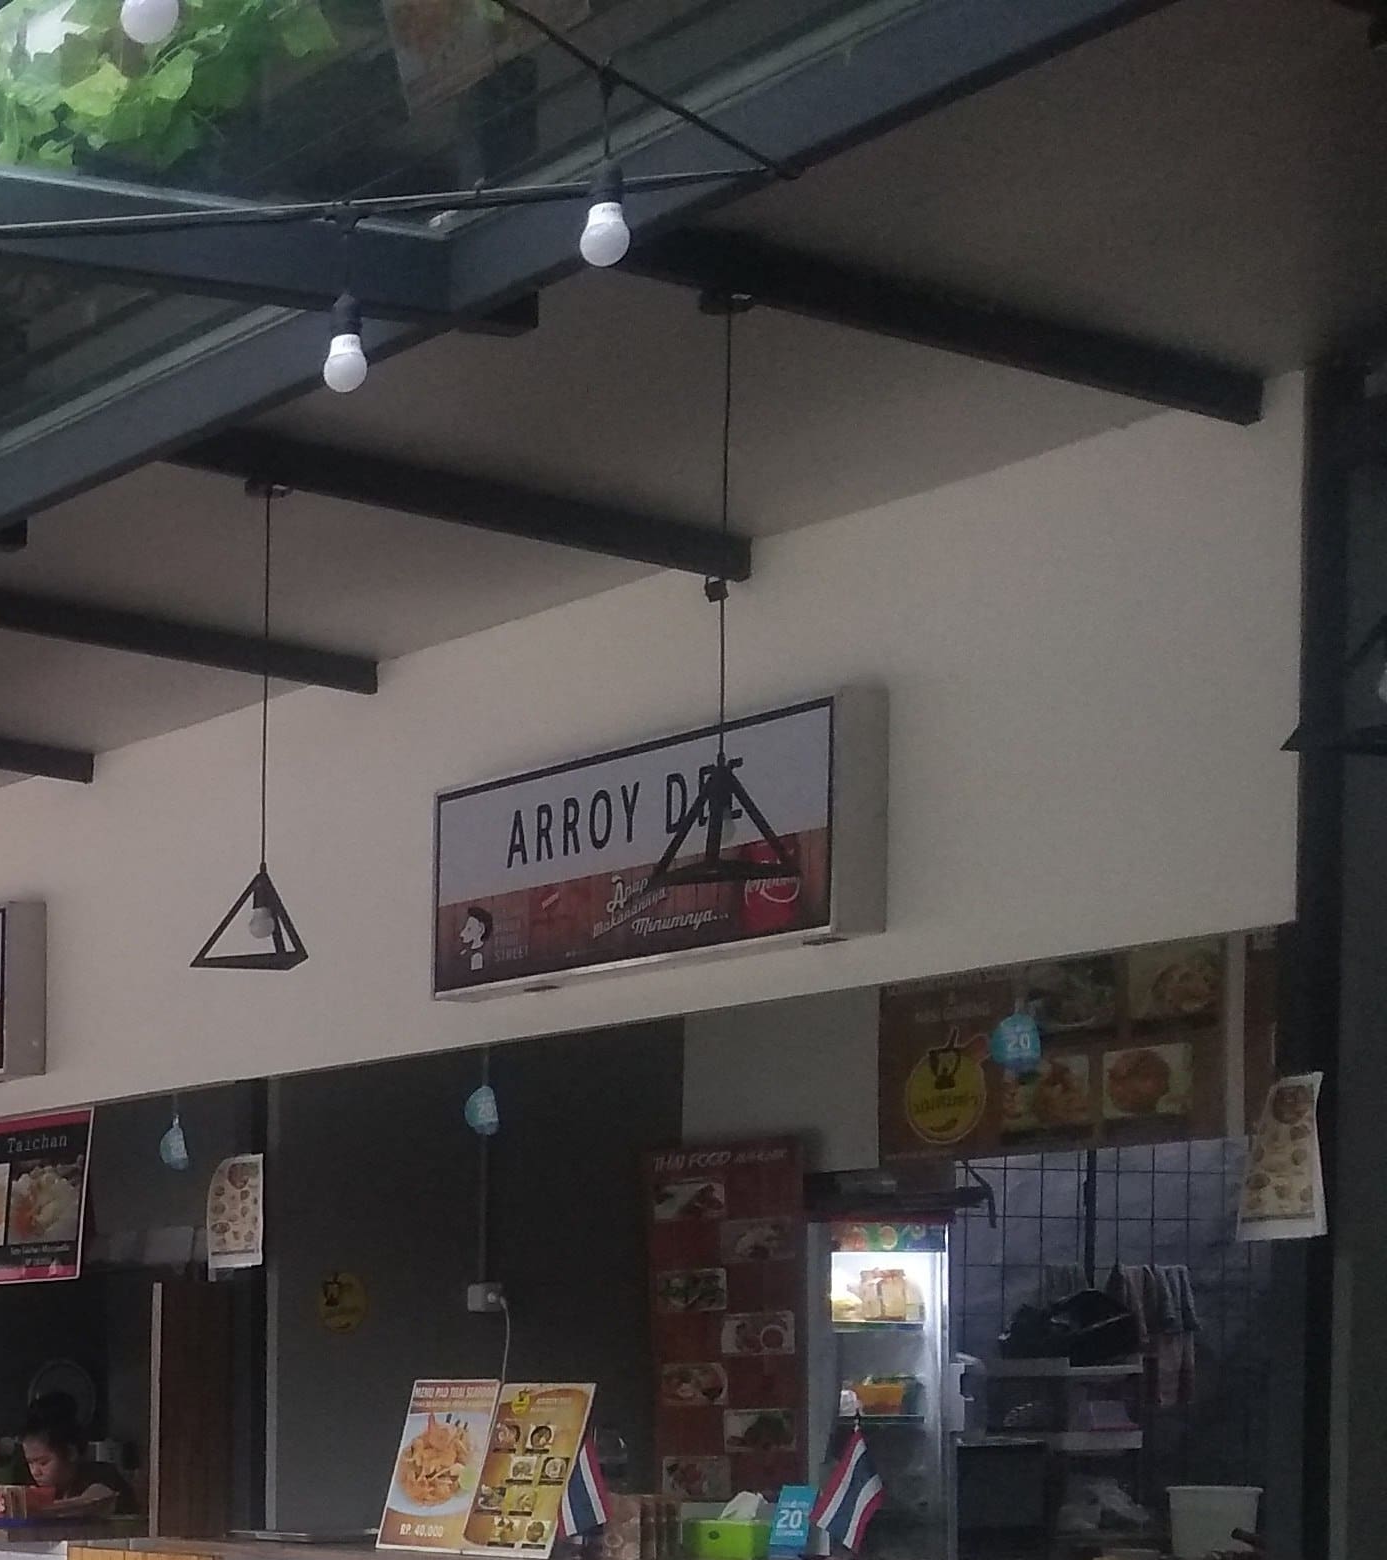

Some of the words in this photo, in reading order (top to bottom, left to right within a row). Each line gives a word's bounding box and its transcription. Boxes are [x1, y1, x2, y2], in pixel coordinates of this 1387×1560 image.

[507, 781, 639, 868] ARROY
[494, 944, 529, 962] STREET
[1007, 1033, 1031, 1051] 20
[7, 1134, 68, 1154] Taichan
[688, 1151, 732, 1168] FOOD
[776, 1509, 803, 1529] 20
[414, 1523, 444, 1537] 40.000
